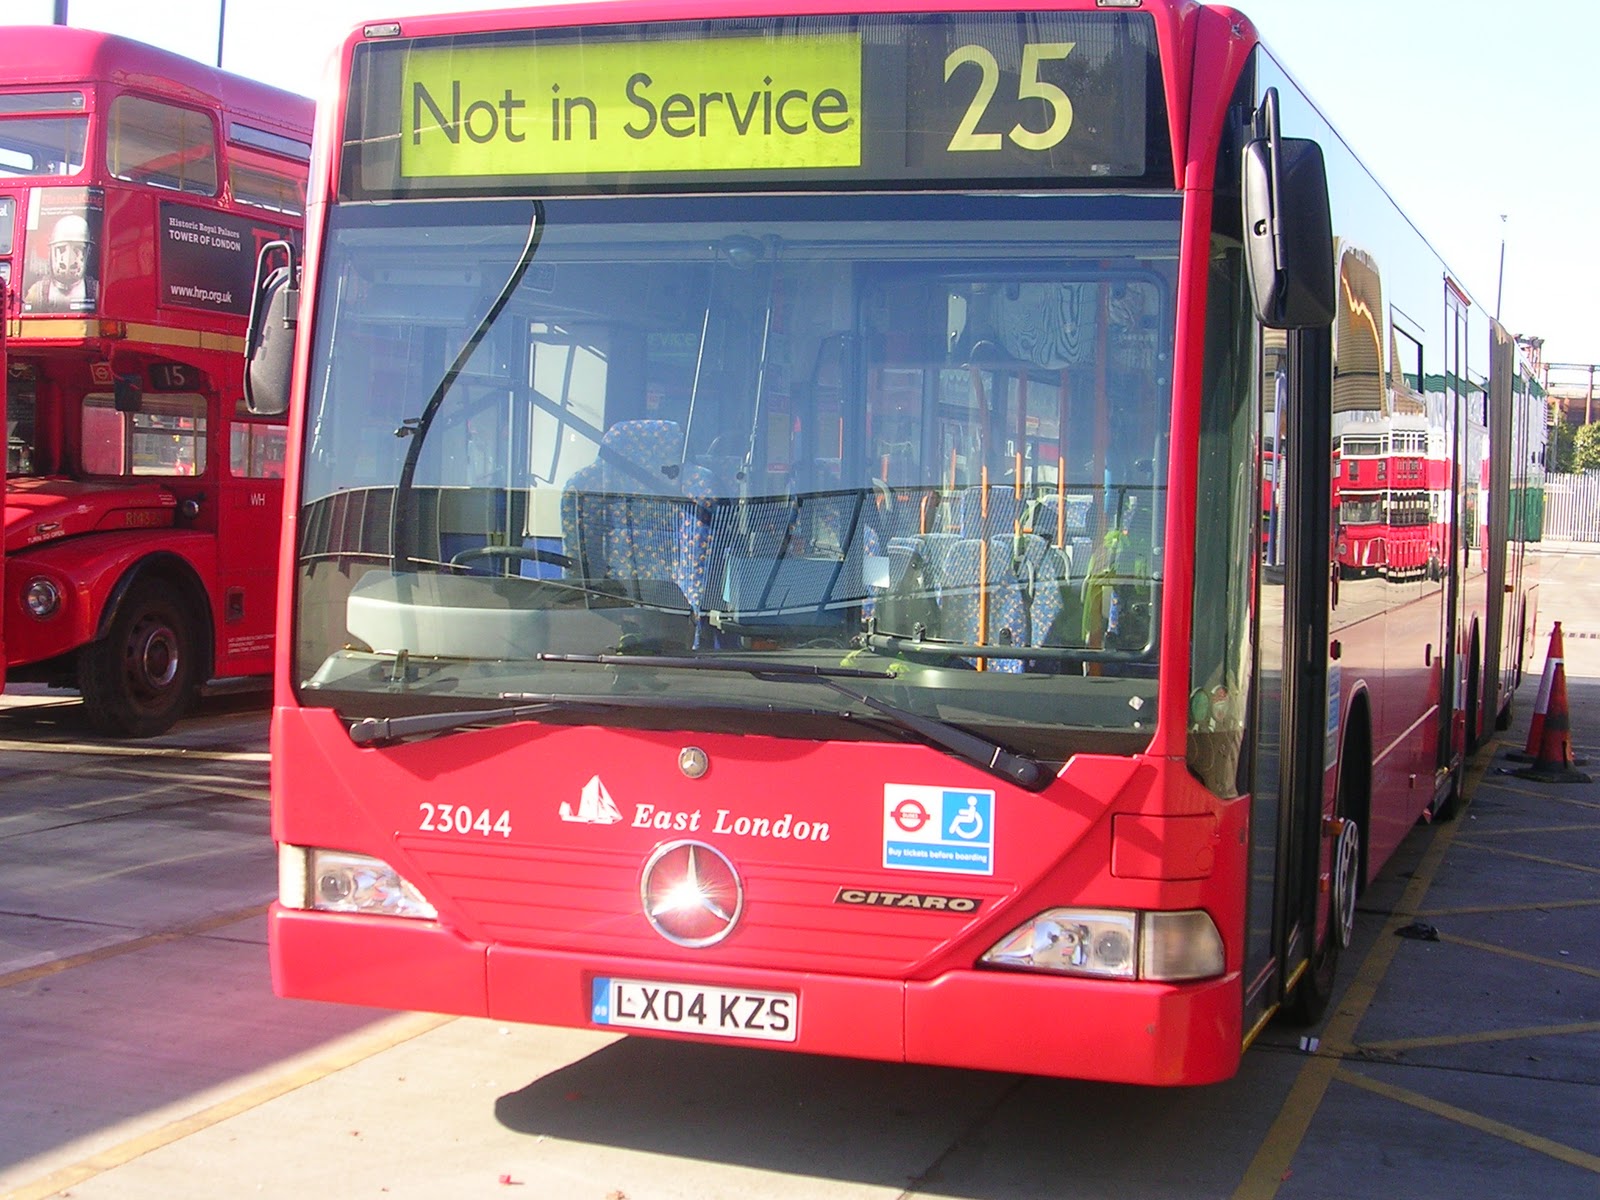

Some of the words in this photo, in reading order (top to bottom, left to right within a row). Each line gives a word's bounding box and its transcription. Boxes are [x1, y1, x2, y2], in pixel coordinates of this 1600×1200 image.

[943, 42, 1077, 152] 25
[413, 81, 526, 146] Not
[551, 83, 599, 142] in
[623, 73, 850, 139] Service
[168, 217, 199, 231] Historic
[199, 223, 217, 233] Royal
[168, 229, 199, 244] TOWER
[200, 234, 210, 245] OF
[211, 236, 241, 251] LONDON
[170, 285, 232, 304] www.hrp.org.uk
[164, 365, 185, 386] 15
[419, 803, 512, 838] 23044
[632, 804, 702, 832] East
[713, 810, 831, 841] London
[888, 847, 902, 857] Buy
[903, 848, 928, 858] tickets
[929, 850, 954, 860] before
[955, 851, 987, 864] boarding
[841, 890, 975, 911] CITARO
[616, 985, 706, 1025] LX04
[720, 994, 790, 1031] KZS
